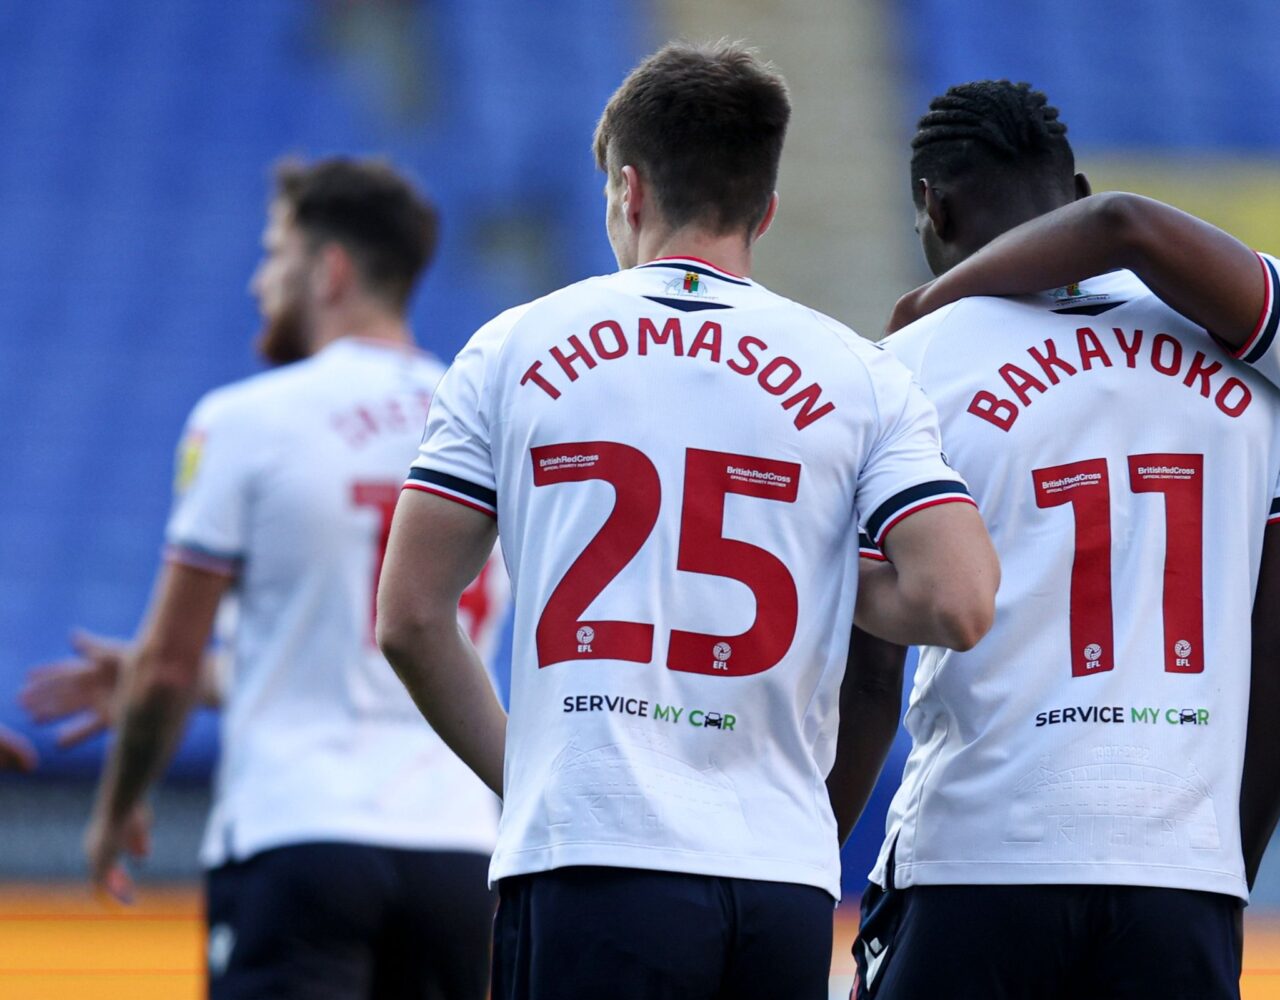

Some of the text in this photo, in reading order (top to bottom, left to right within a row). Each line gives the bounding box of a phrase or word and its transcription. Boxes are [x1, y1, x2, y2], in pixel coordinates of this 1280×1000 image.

[520, 317, 835, 431] THOMASON
[966, 327, 1252, 432] BAKAYOKO
[530, 441, 801, 677] 25
[1031, 453, 1204, 677] 11
[577, 644, 592, 653] EFL
[713, 660, 729, 670] EFL
[1086, 660, 1101, 669] EFL
[1175, 658, 1190, 667] EFL
[563, 695, 648, 717] SERVICE
[653, 702, 684, 724] MY
[1036, 706, 1124, 727] SERVICE
[1131, 707, 1160, 725] MY
